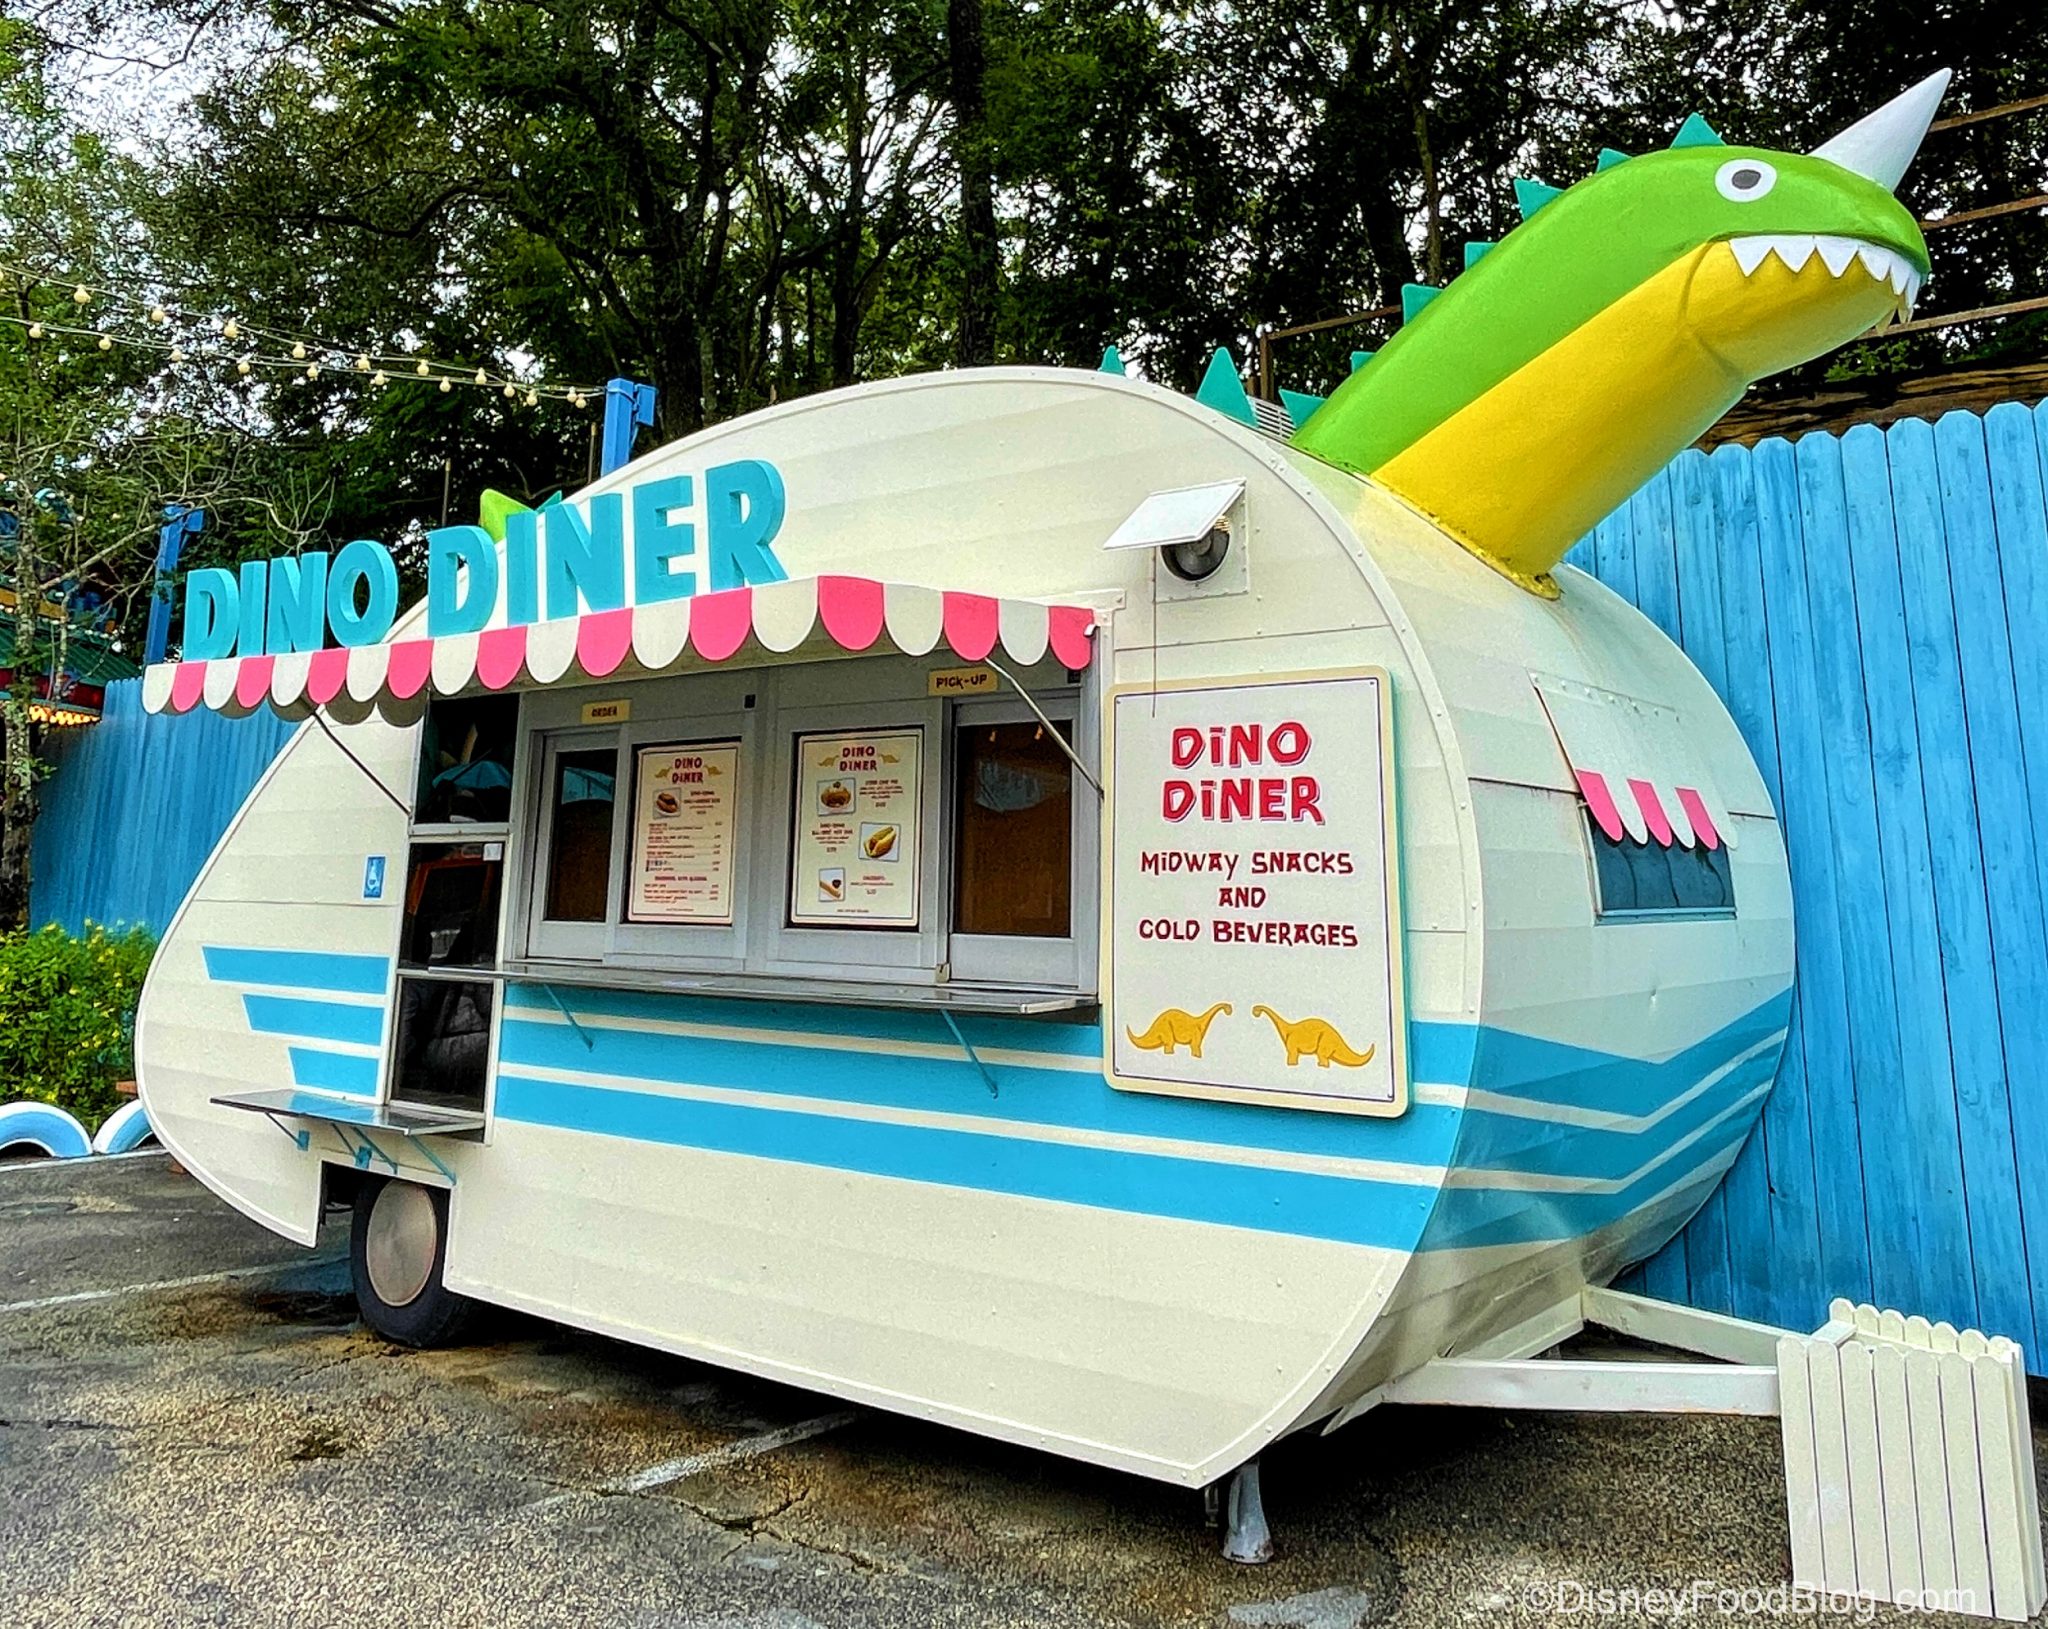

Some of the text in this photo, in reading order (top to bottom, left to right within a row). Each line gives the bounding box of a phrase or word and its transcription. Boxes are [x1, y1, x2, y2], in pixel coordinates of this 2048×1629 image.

[182, 459, 788, 662] DINO DINER
[936, 674, 987, 689] PICK-UP
[842, 746, 875, 758] DINO
[674, 757, 702, 769] DINO
[840, 760, 877, 771] DINER
[672, 772, 703, 784] DINER
[1252, 851, 1354, 875] SNACKS
[1219, 887, 1266, 908] AND
[1139, 919, 1358, 947] COLD BEVERAGES
